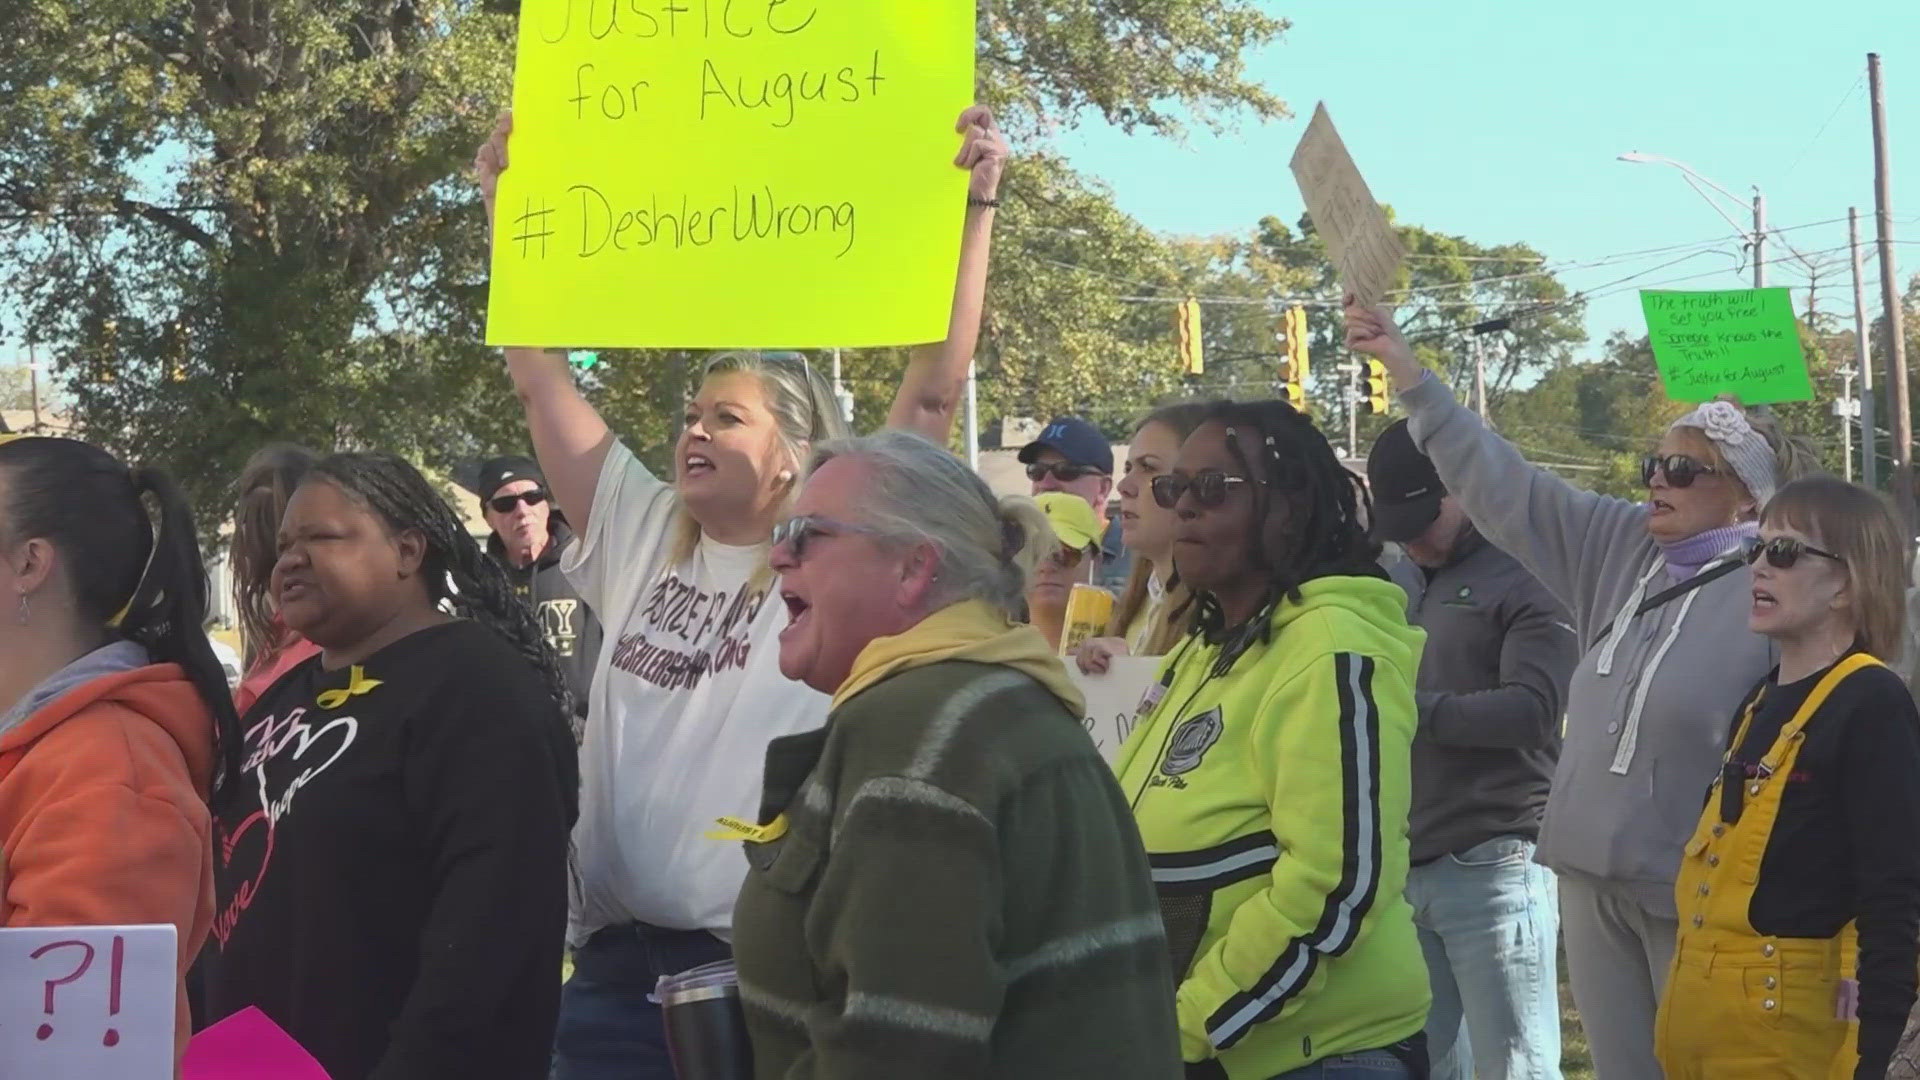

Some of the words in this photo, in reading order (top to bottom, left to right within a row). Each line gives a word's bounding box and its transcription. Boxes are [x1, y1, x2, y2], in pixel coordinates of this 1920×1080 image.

[568, 63, 649, 120] for
[699, 49, 886, 128] August
[1648, 295, 1674, 310] The
[1682, 293, 1722, 308] truth
[1728, 291, 1754, 304] will
[1698, 311, 1723, 326] you
